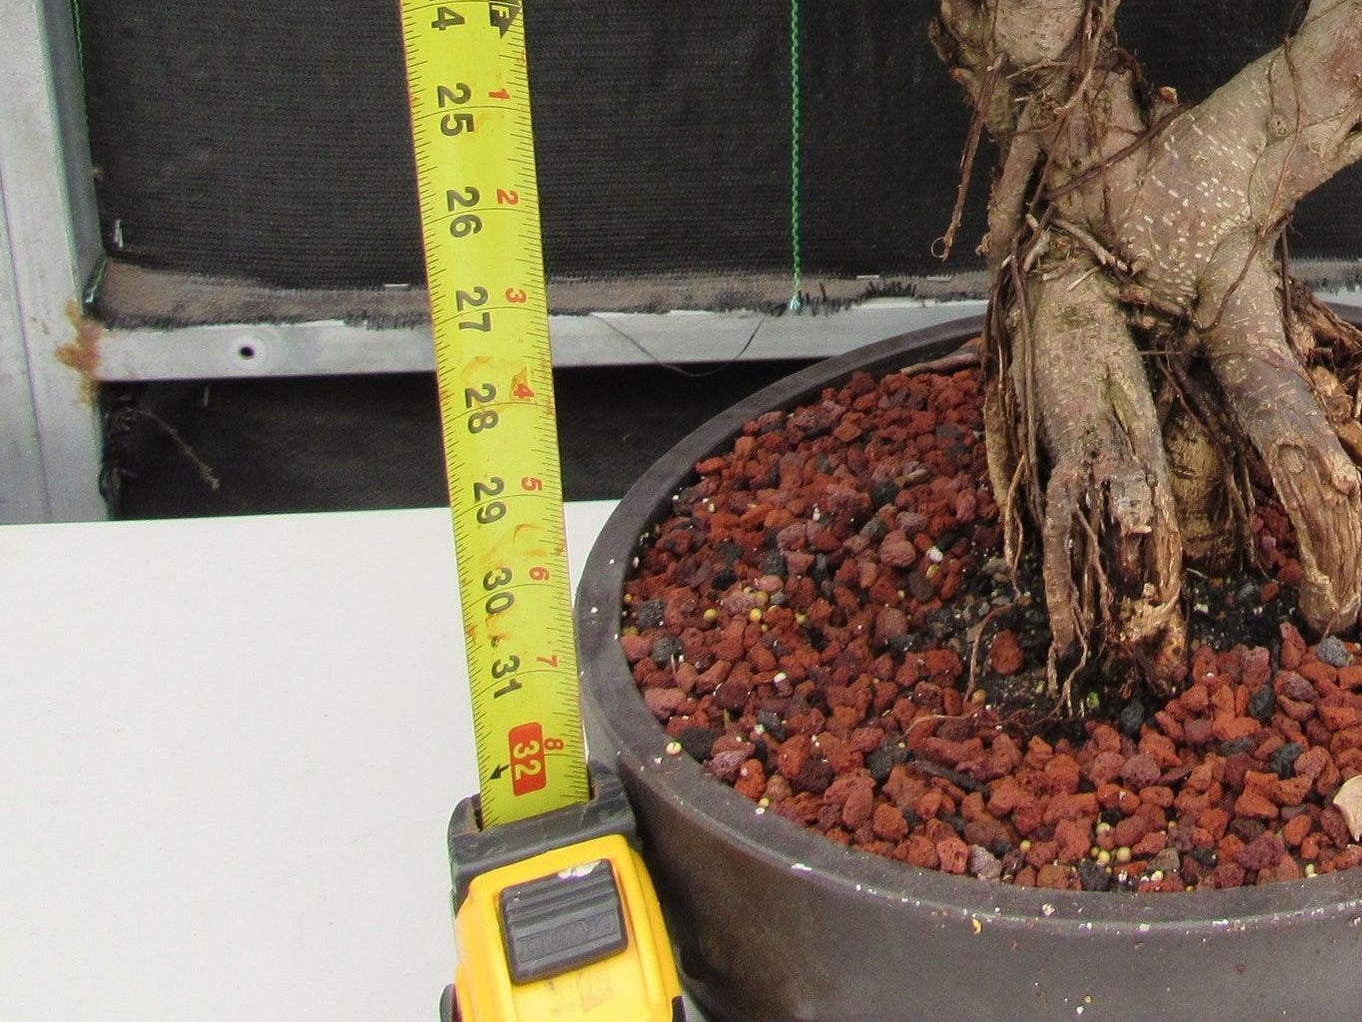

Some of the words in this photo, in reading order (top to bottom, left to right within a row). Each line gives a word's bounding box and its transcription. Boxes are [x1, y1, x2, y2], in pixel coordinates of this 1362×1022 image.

[488, 88, 511, 100] 1
[437, 82, 475, 136] 25
[496, 188, 519, 205] 2
[446, 186, 483, 238] 26
[455, 286, 492, 332] 27
[505, 287, 527, 303] 3
[513, 383, 535, 399] 4
[464, 383, 499, 434] 28
[520, 476, 543, 491] 5
[473, 476, 507, 524] 29
[528, 566, 550, 582] 6
[483, 567, 515, 615] 30
[536, 655, 559, 668] 7
[491, 655, 523, 699] 31
[544, 737, 564, 751] 8
[513, 740, 541, 781] 32
